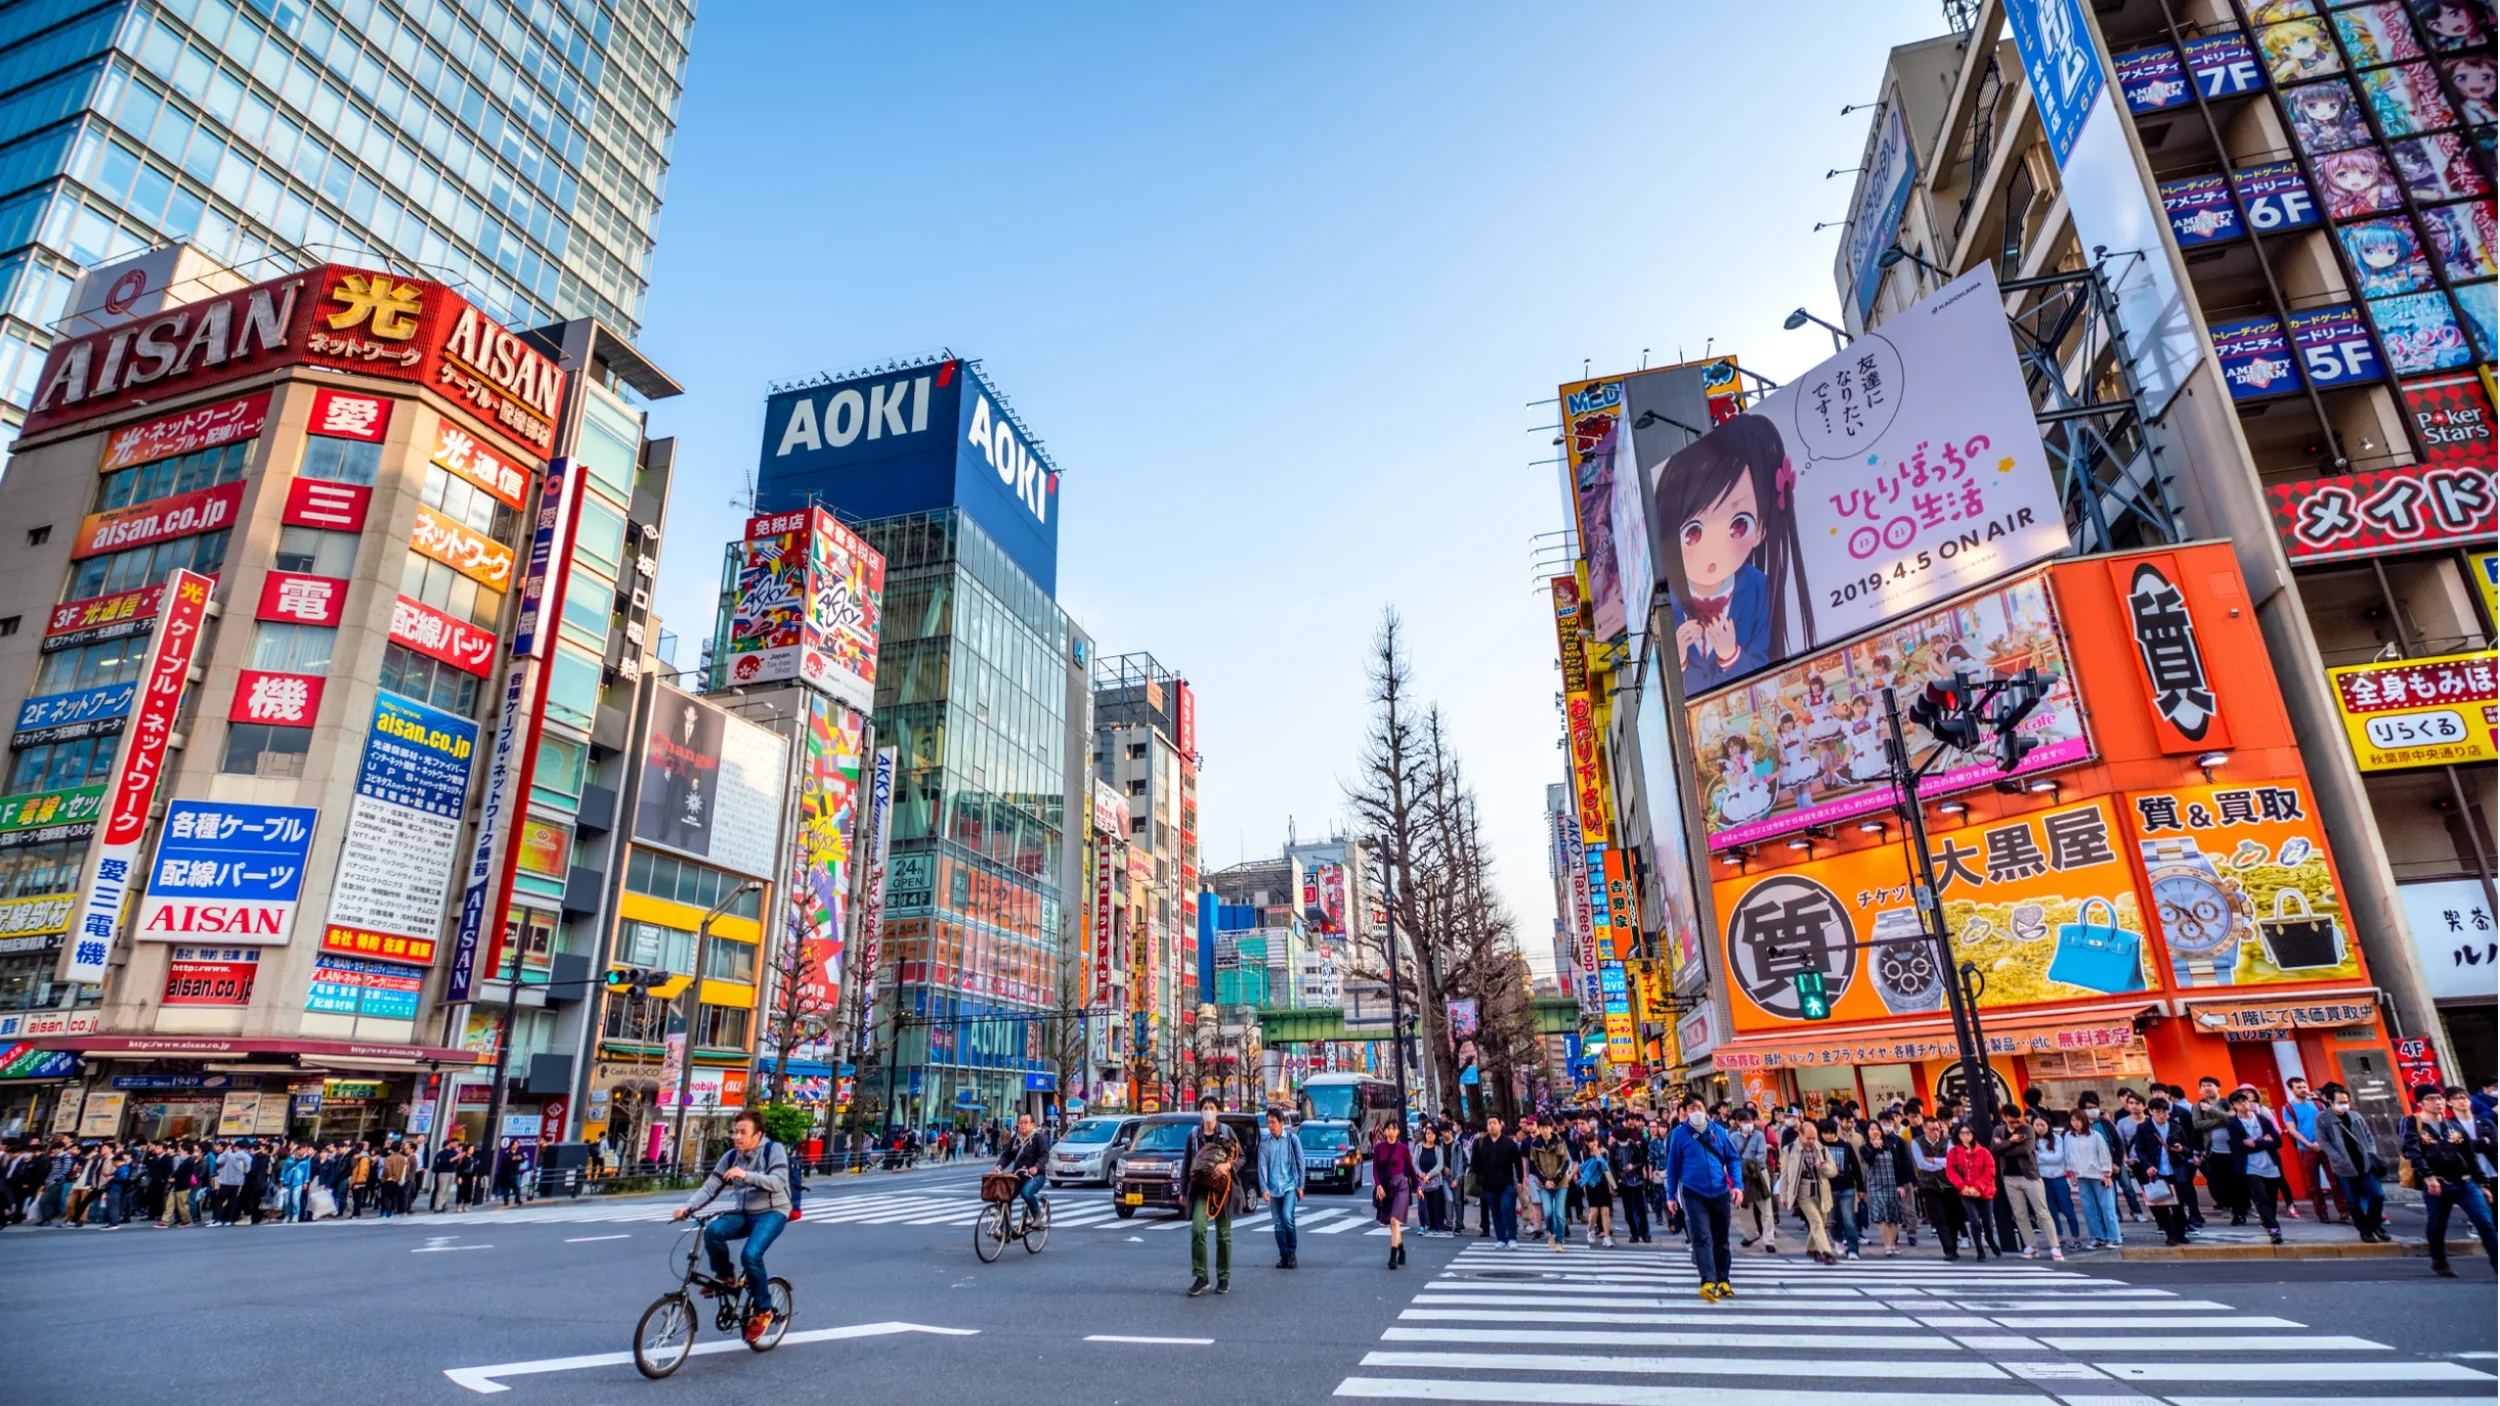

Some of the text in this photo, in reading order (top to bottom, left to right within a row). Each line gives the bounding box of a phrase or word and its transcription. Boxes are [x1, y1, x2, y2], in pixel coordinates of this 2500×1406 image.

[2198, 62, 2259, 95] 7F
[2249, 191, 2312, 228] 6F
[328, 275, 423, 341] 光
[1938, 281, 1983, 311] KADOKAWA
[33, 280, 305, 413] AISAN
[308, 333, 422, 367] ネットワーク
[446, 305, 564, 419] AISAN
[2309, 341, 2373, 379] 5F
[1857, 352, 1884, 414] 友達に
[776, 377, 931, 457] AOKI
[1835, 370, 1864, 437] なりたい
[105, 427, 146, 468] 光
[2424, 424, 2489, 444] Stars
[434, 429, 524, 500] 光通信
[968, 393, 1048, 525] AOKI
[1830, 434, 1991, 520] ひとりぼっちの
[92, 498, 227, 550] aisan.co.jp
[754, 514, 805, 536] 免税店
[2304, 473, 2488, 538] メイド
[249, 396, 379, 721] 愛 三 電 機
[413, 513, 513, 581] ネットワーク
[1830, 551, 1932, 608] 2019.4.5
[1939, 528, 1981, 560] ON
[1987, 507, 2035, 541] AIR
[519, 506, 557, 637] 愛三電機
[54, 607, 80, 628] 3F
[391, 600, 494, 665] 配線パーツ
[1560, 618, 1577, 626] DVD
[1565, 642, 1577, 650] CD
[2127, 583, 2216, 721] 質
[114, 581, 204, 831] 光・ケーブル・ネットワーク
[2350, 666, 2498, 706] 全身もみほ
[21, 703, 48, 724] 2F
[2375, 717, 2457, 742] りらくる
[376, 712, 471, 759] aisan.co.jp
[2370, 744, 2482, 766] 秋葉原中央通り店
[171, 811, 306, 844] 各種ケーブル
[895, 859, 923, 876] 24h
[1930, 806, 2116, 895] 大黒屋
[159, 859, 295, 890] 配線パーツ
[893, 878, 923, 889] OPEN
[75, 858, 129, 966] 愛三電機
[145, 904, 285, 934] AISAN
[1574, 873, 1595, 972] Tax-free Shop
[453, 890, 481, 991] AISAN
[1741, 887, 1850, 1004] 質
[1604, 980, 1625, 990] DVD
[2057, 1027, 2131, 1049] 無料査定
[2401, 1042, 2424, 1057] 4F
[1715, 1053, 1760, 1067] 高価買取
[172, 1076, 199, 1087] 1949
[724, 1080, 744, 1092] au
